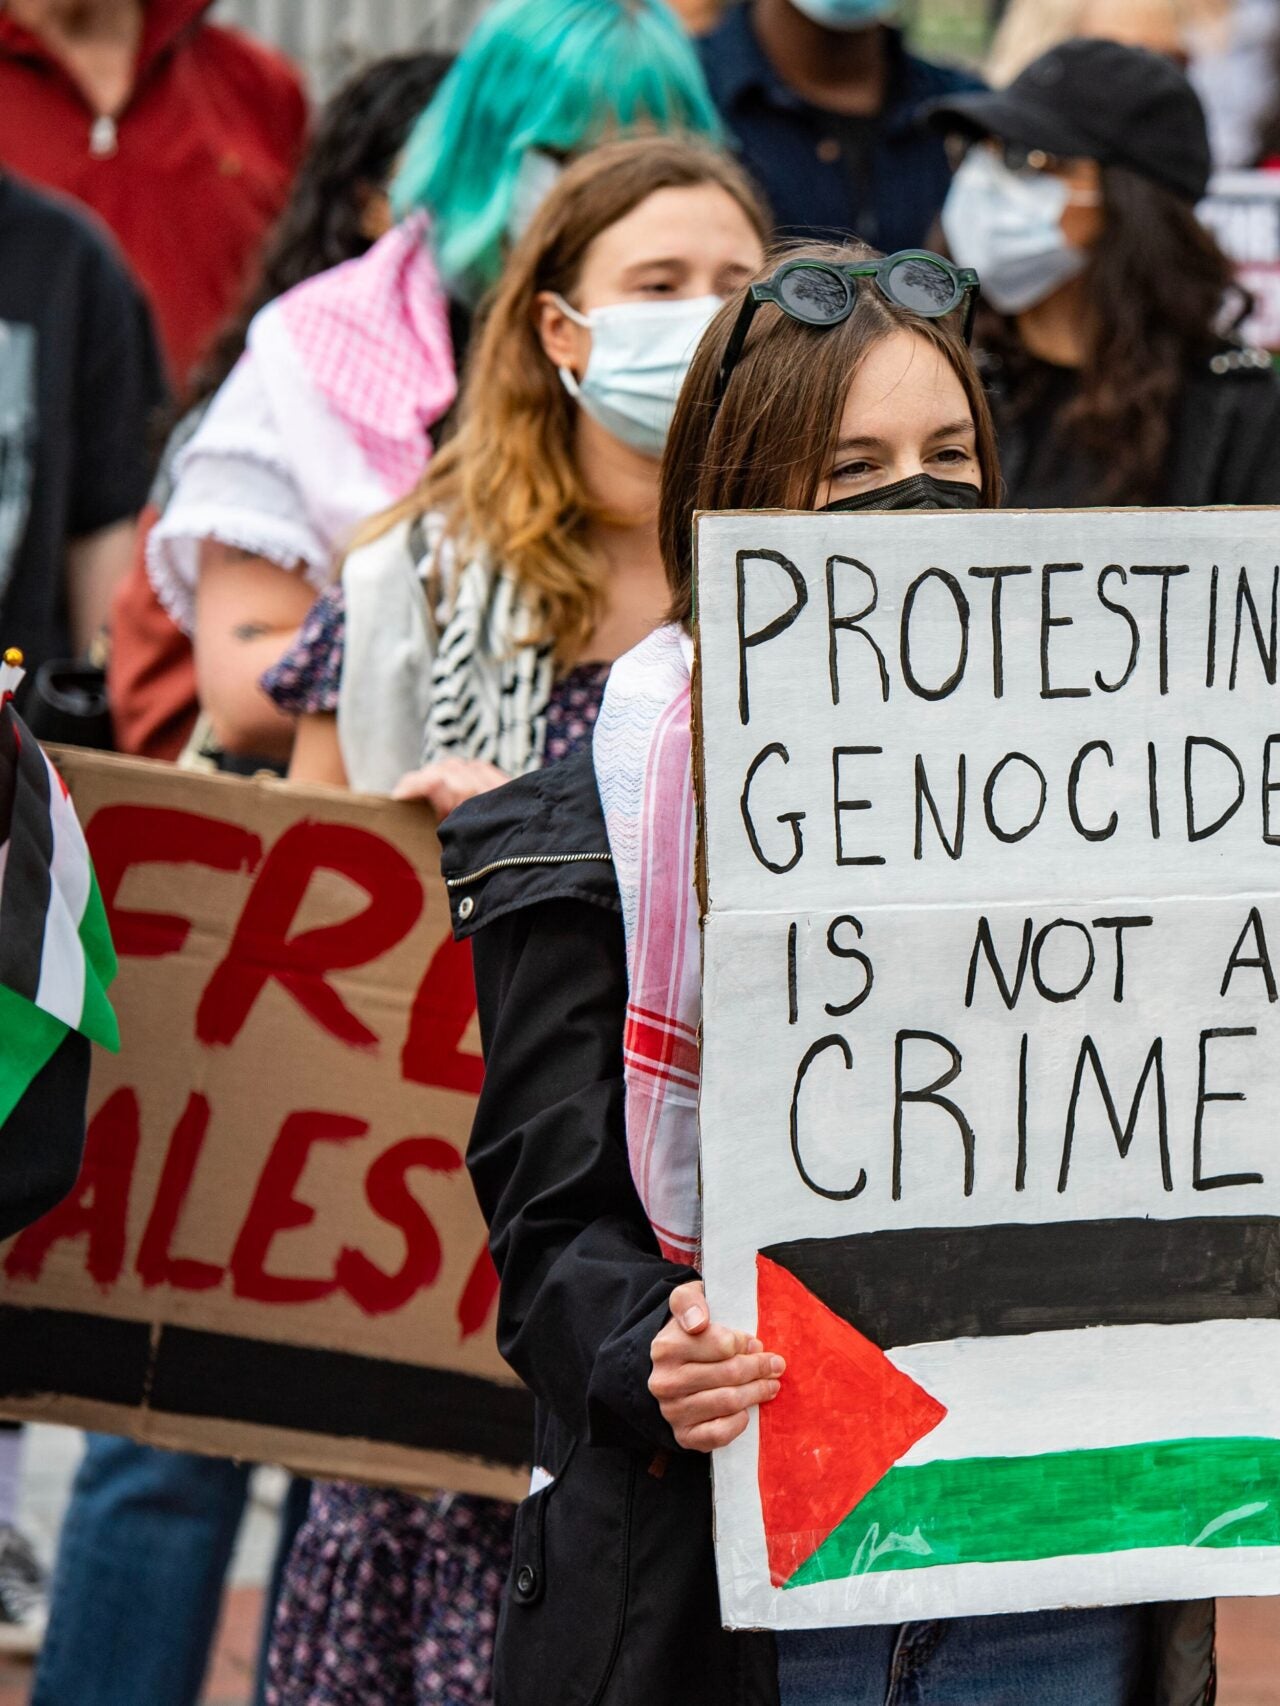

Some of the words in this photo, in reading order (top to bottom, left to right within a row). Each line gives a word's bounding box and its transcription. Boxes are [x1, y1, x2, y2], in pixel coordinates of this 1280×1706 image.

[788, 915, 874, 1025] IS
[965, 916, 1154, 1011] NOT
[1220, 907, 1278, 1003] A
[790, 1027, 1264, 1201] CRIME
